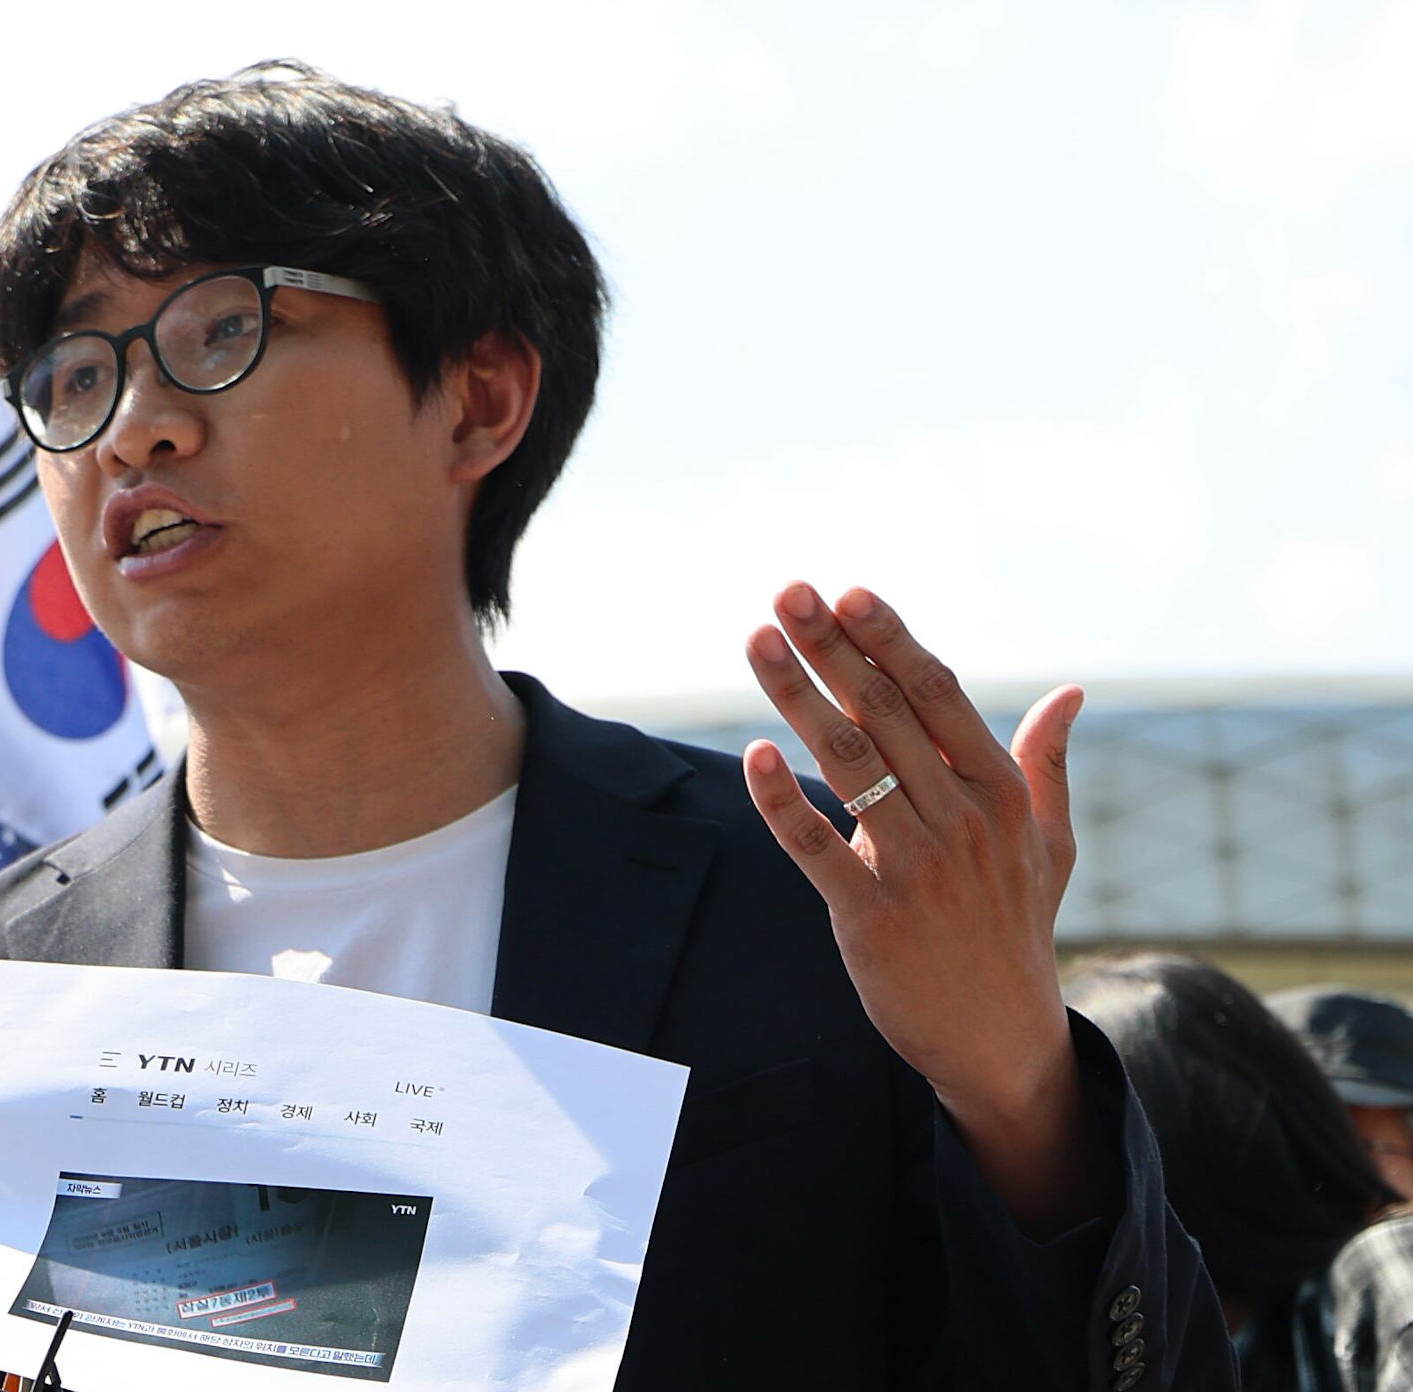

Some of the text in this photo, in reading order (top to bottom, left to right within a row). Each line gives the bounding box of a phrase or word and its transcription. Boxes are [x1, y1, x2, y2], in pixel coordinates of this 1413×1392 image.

[137, 1053, 258, 1078] YTN 시리즈
[394, 1081, 435, 1098] LIVE
[90, 1087, 444, 1136] 홈 월드컵 정치 경제 사회 국제
[66, 1183, 102, 1195] 자막뉴스
[390, 1204, 417, 1216] YTN
